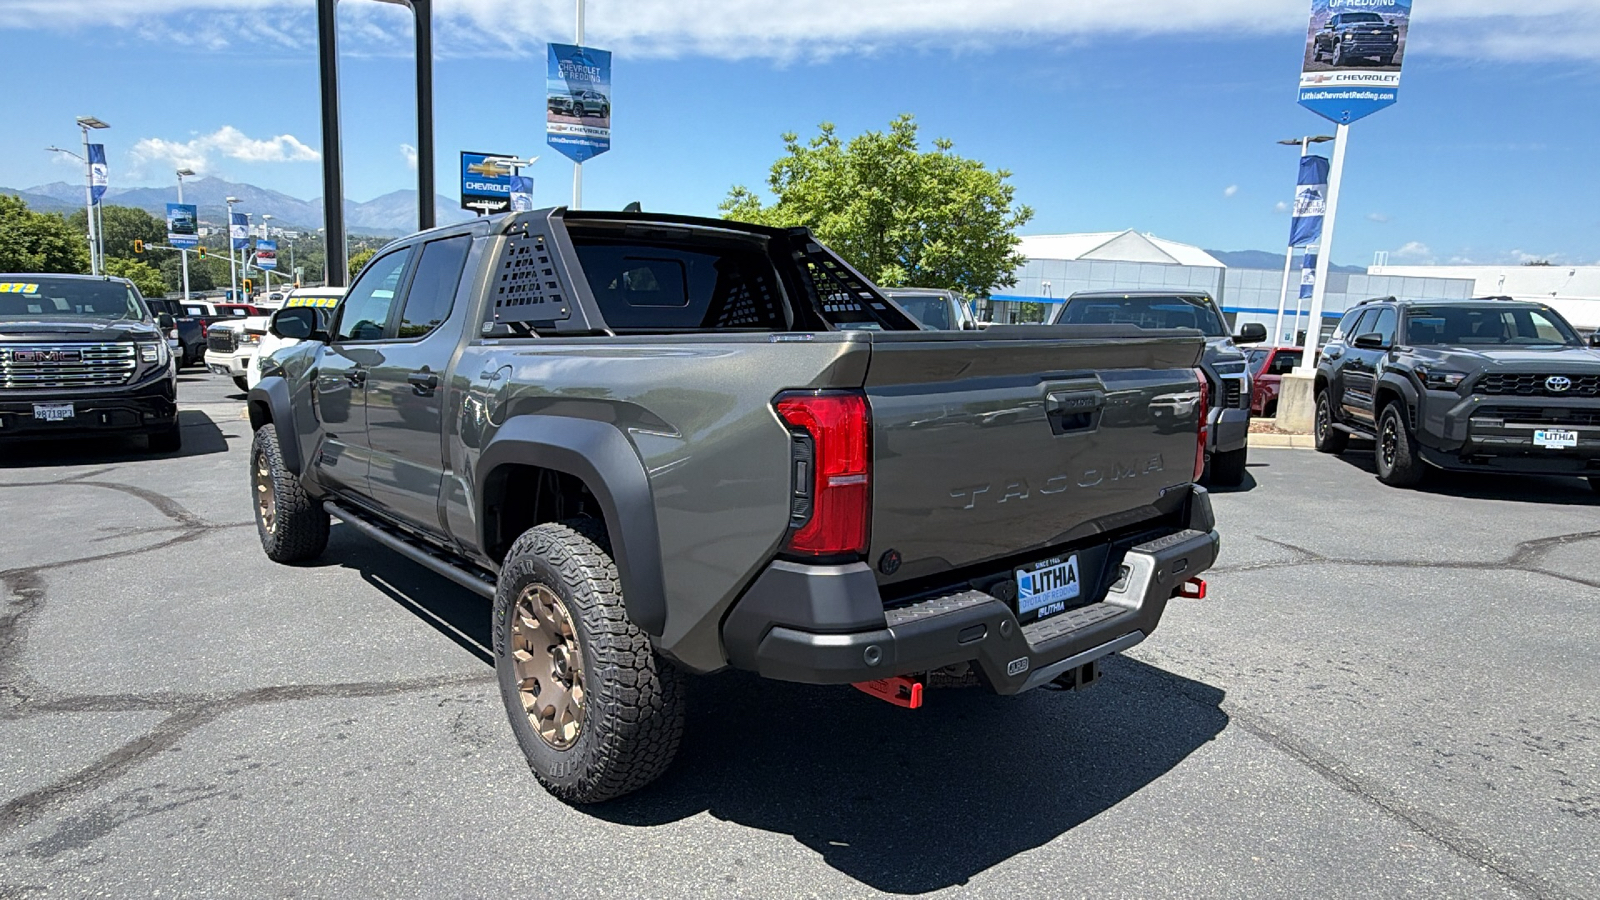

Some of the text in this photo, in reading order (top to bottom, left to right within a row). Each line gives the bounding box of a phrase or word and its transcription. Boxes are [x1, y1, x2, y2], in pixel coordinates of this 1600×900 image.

[558, 63, 601, 75] CHEVROLET
[569, 71, 601, 82] REDDING
[1336, 74, 1397, 82] CHEVROLET
[1301, 91, 1394, 101] LithiaChevroletRedding.com
[569, 126, 608, 136] CHEVROLET
[15, 351, 79, 362] GMC
[1544, 432, 1575, 441] LITHIA
[950, 453, 1163, 509] TACOMA
[1031, 564, 1077, 596] LITHIA
[1051, 584, 1078, 599] REDDING
[1044, 601, 1066, 616] LITHIA
